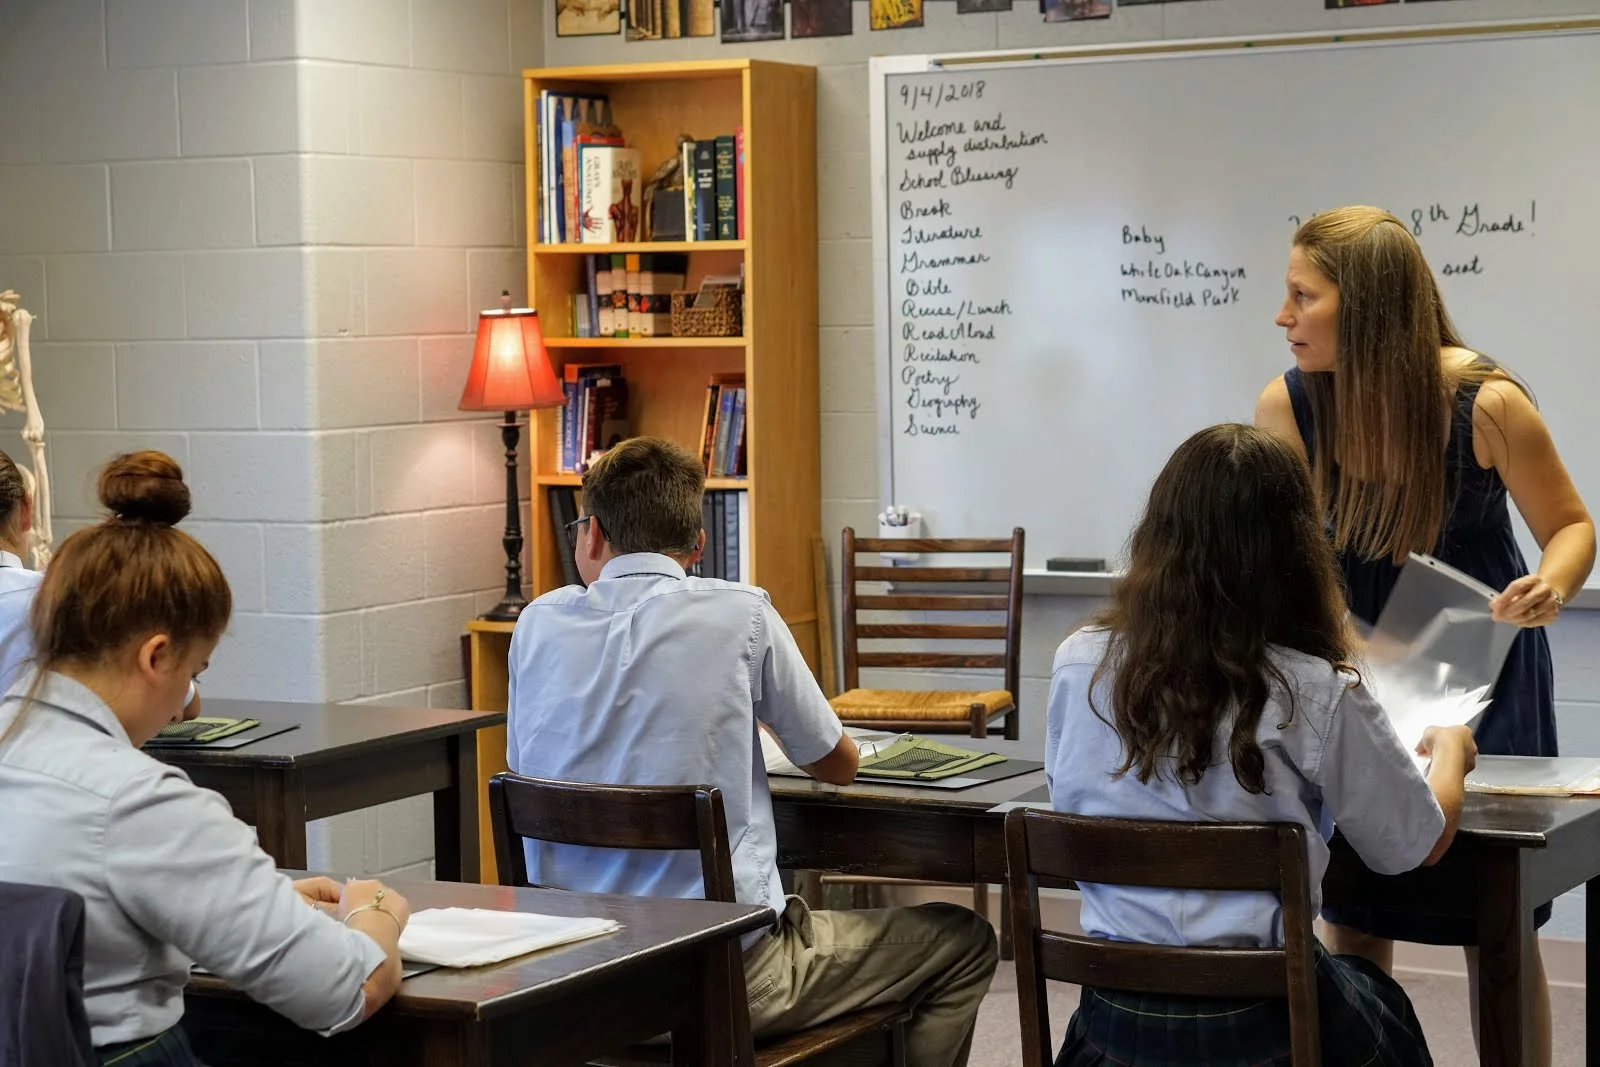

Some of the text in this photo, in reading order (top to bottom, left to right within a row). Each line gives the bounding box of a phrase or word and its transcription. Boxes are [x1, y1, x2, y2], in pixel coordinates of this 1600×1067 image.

[899, 80, 986, 110] 9/4/2018
[896, 112, 1006, 144] Welcome and
[905, 130, 1048, 167] supply distribution
[899, 165, 1019, 192] School Blessing
[900, 198, 952, 220] Break
[1410, 203, 1450, 237] 8th
[901, 225, 983, 245] Literature
[1121, 224, 1166, 255] Baby
[900, 250, 991, 275] Grammar
[1164, 259, 1194, 279] Oak
[1195, 262, 1247, 291] Canyon
[1442, 255, 1484, 276] seat
[905, 277, 952, 297] Bible
[1121, 286, 1241, 309] Mansfield Park
[902, 321, 949, 341] Read
[904, 343, 980, 364] Recitation
[901, 365, 961, 395] Poetry
[906, 387, 982, 420] Geography
[904, 413, 960, 436] Science
